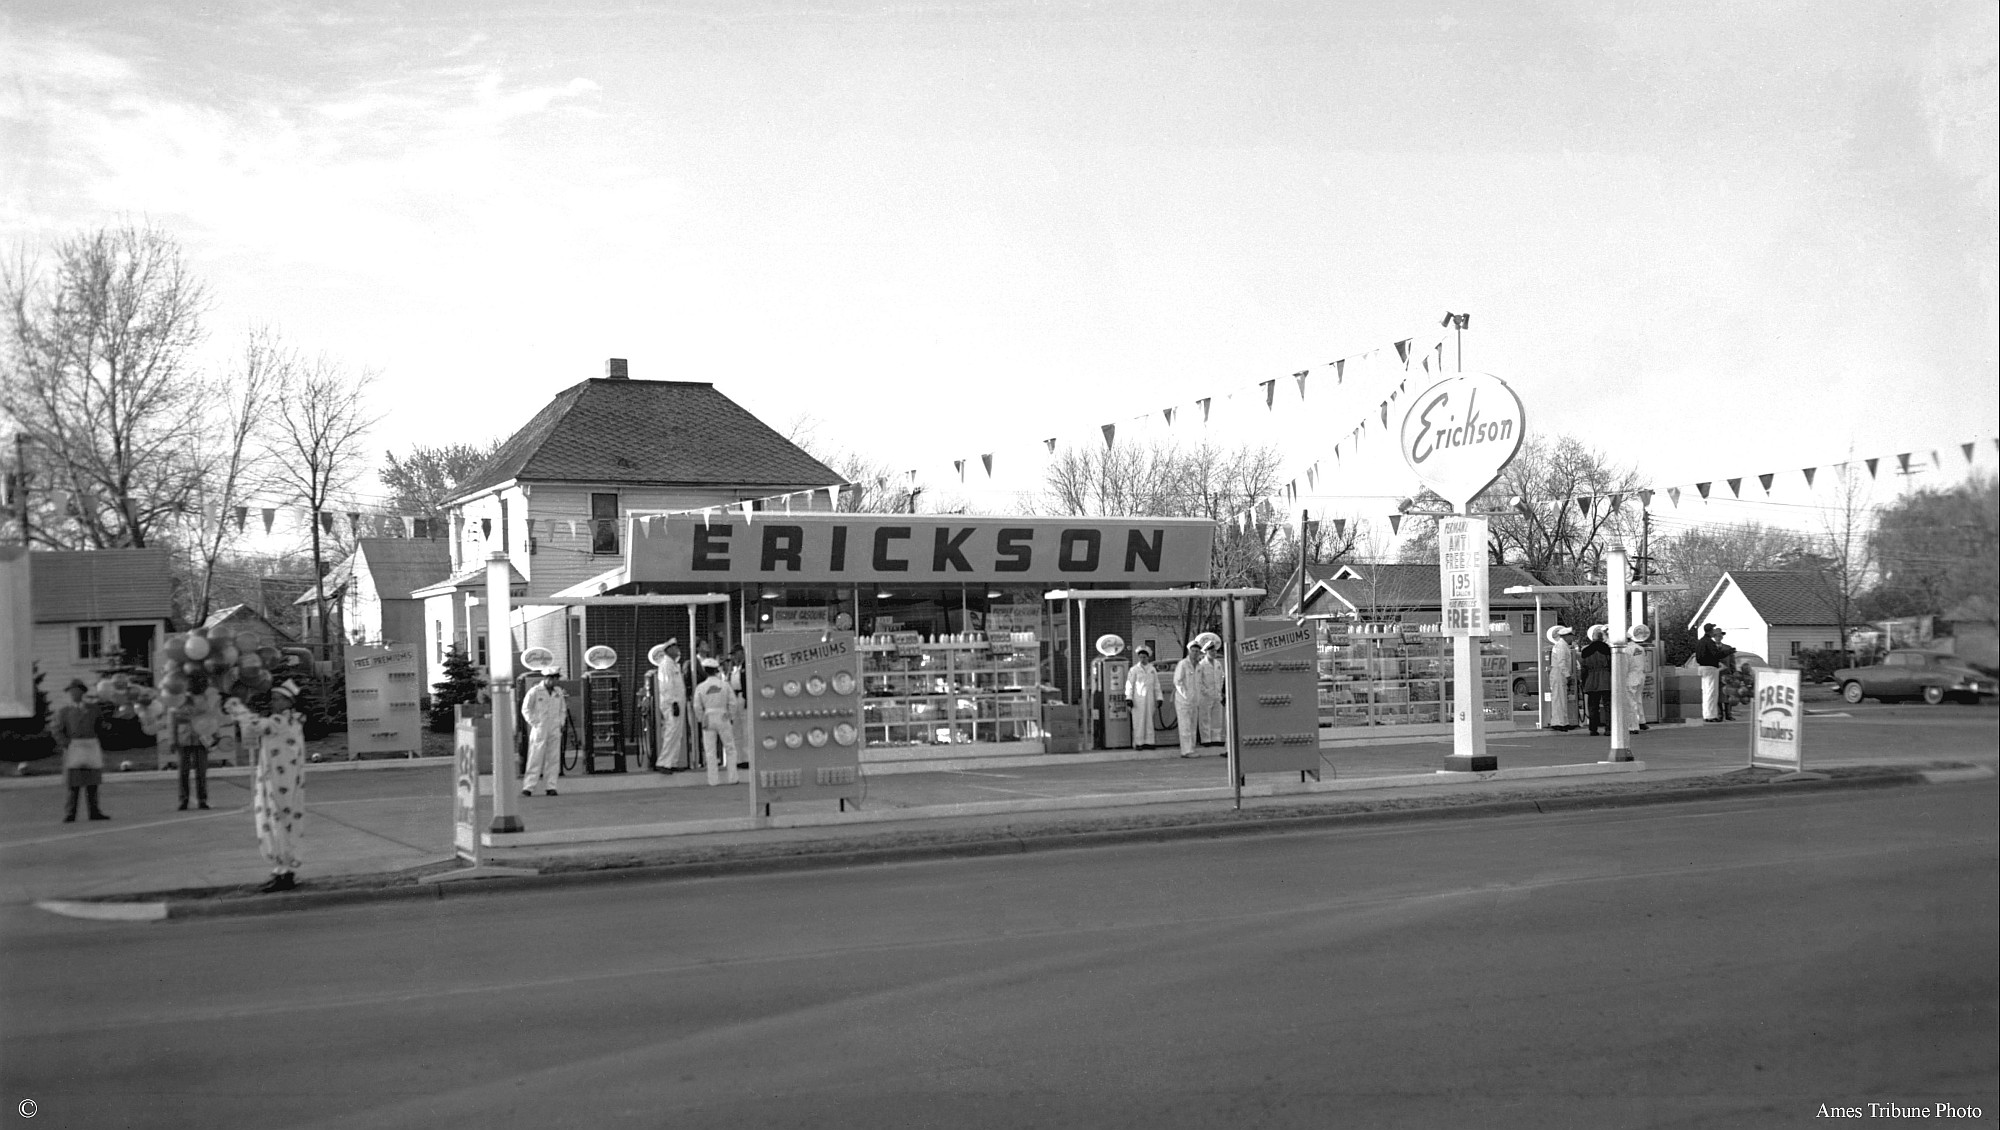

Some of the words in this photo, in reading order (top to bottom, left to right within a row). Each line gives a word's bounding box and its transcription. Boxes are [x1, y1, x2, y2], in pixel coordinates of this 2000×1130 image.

[1412, 387, 1512, 464] Erickson
[691, 524, 1164, 572] ERICKSON
[1446, 552, 1480, 569] FREEZE
[1452, 574, 1471, 597] 1.95
[1447, 608, 1481, 629] FREE
[1240, 640, 1259, 654] FREE
[1263, 629, 1310, 649] PREMIUMS
[763, 653, 786, 668] FREE
[790, 642, 846, 664] PREMIUMS
[1759, 685, 1795, 710] FREE
